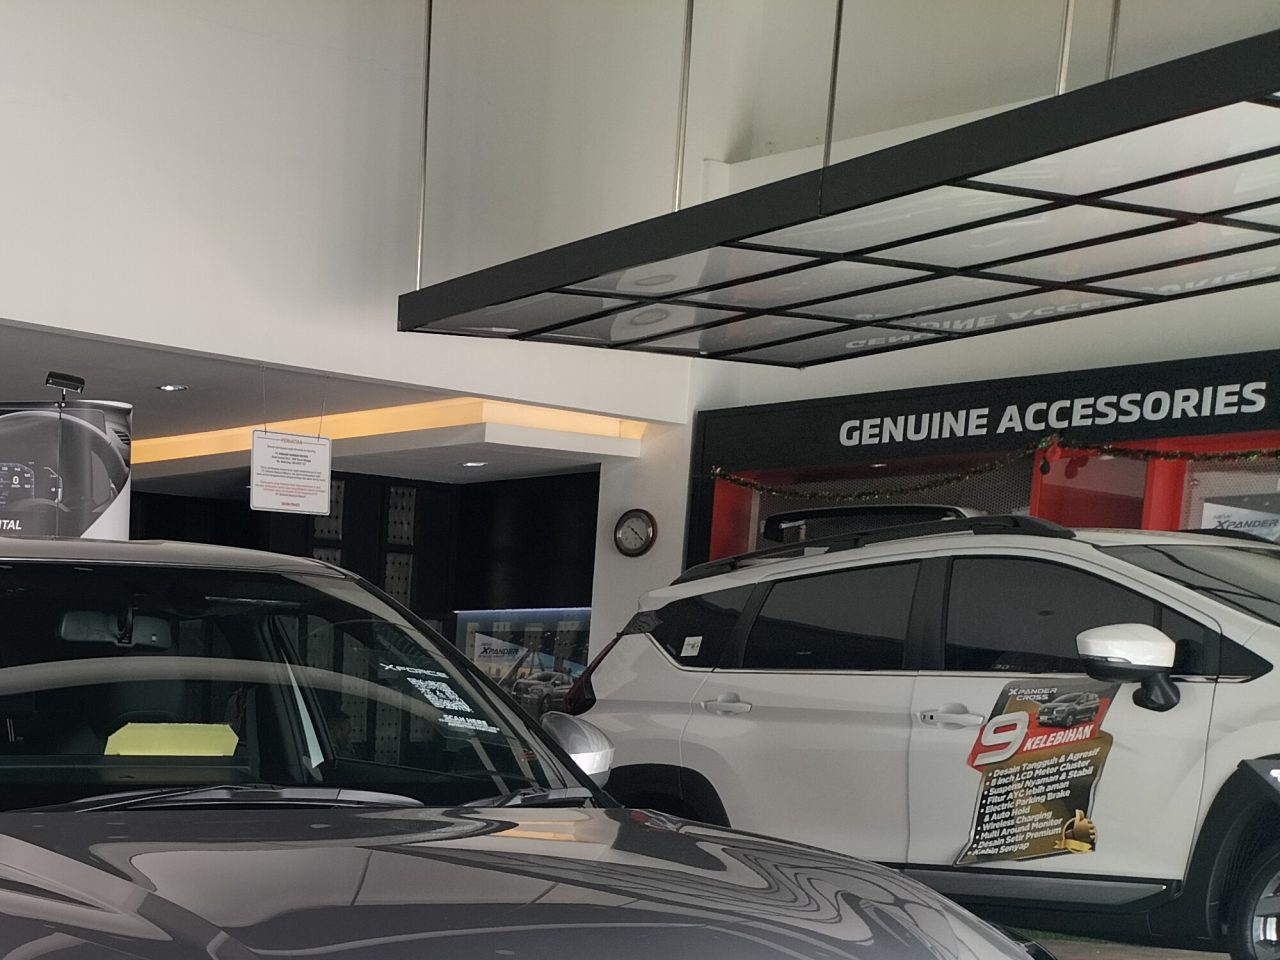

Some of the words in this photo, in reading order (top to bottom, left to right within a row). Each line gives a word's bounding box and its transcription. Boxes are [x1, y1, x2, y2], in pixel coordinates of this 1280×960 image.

[839, 408, 990, 448] GENUINE
[997, 381, 1267, 434] ACCESSORIES
[1213, 519, 1279, 530] XPANDER
[1008, 687, 1058, 696] XPANDER
[973, 711, 1029, 766] 9
[1023, 725, 1094, 751] KELEBIHAN
[993, 766, 1020, 777] Desain
[1022, 757, 1057, 771] Tangguh
[1059, 754, 1066, 763] &
[1066, 747, 1100, 762] Agresif
[1015, 770, 1033, 781] LCD
[1034, 765, 1058, 777] Meter
[1059, 759, 1090, 771] Cluster
[989, 782, 1024, 795] Suspensi
[1025, 774, 1058, 788] Nyaman
[1059, 772, 1067, 780] &
[1067, 766, 1094, 779] Stabil
[985, 801, 1014, 813] Electric
[1015, 794, 1046, 807] Parking
[1047, 789, 1070, 800] Brake
[987, 795, 1006, 805] Fitur
[1007, 789, 1024, 800] AYC
[1046, 781, 1069, 792] aman
[982, 818, 1014, 831] Wireless
[1015, 811, 1053, 824] Charging
[991, 811, 1010, 821] Auto
[1011, 806, 1031, 816] Hold
[978, 837, 1004, 848] Desain
[1005, 834, 1025, 844] Setir
[1025, 827, 1062, 840] Premium
[980, 829, 1000, 840] Multi
[1000, 823, 1030, 836] Around
[1031, 818, 1063, 829] Monitor
[999, 842, 1030, 854] Senyap
